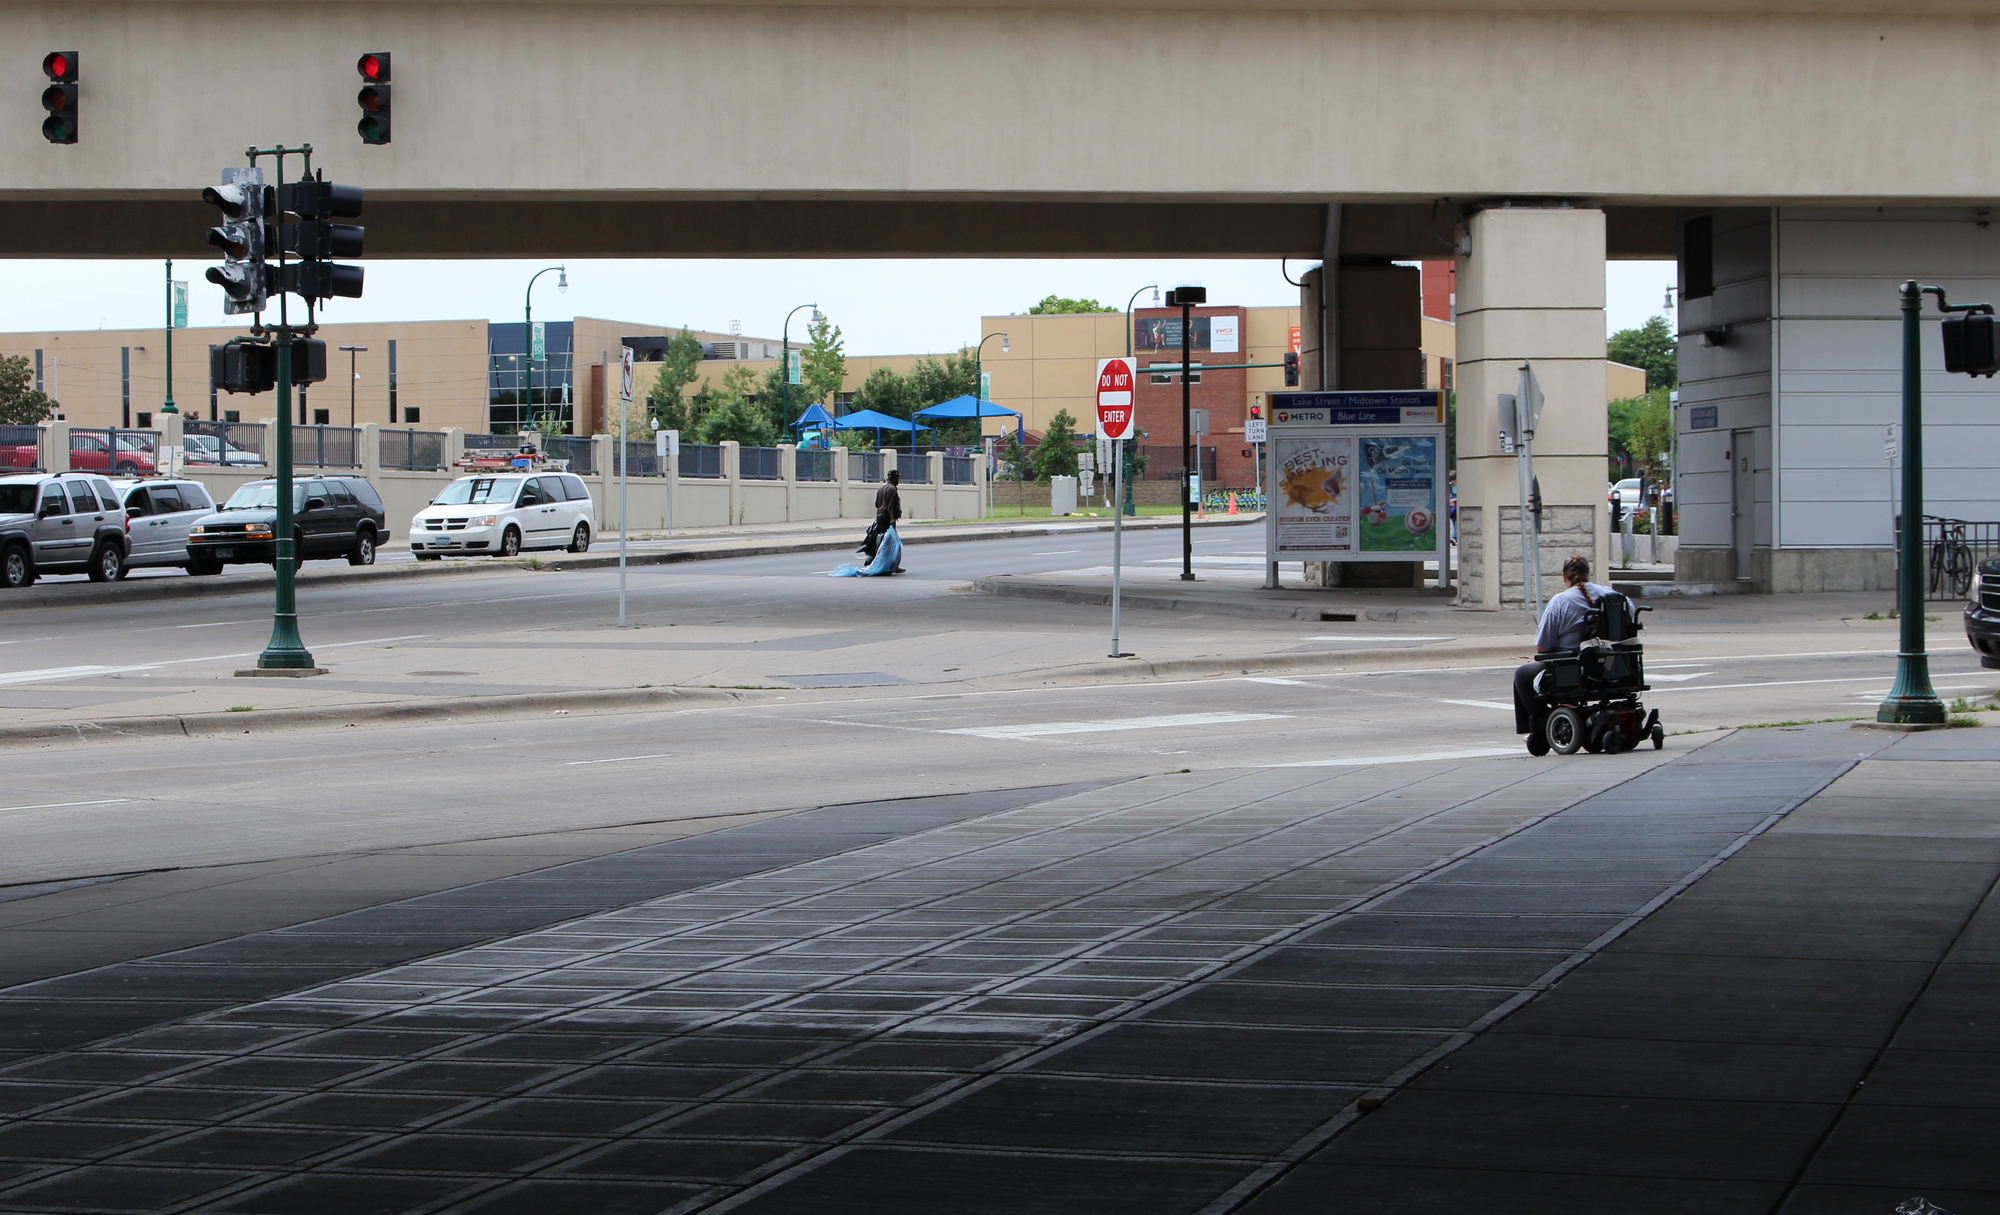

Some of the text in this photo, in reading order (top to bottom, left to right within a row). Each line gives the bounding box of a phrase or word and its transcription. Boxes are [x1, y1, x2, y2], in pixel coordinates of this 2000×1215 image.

[1101, 374, 1129, 387] DO NOT
[1292, 397, 1313, 406] Lake
[1314, 397, 1341, 406] Street
[1348, 396, 1387, 405] Midtown
[1389, 395, 1420, 405] Station
[1103, 410, 1125, 423] ENTER
[1290, 412, 1324, 421] METRO
[1337, 411, 1376, 421] Blue Line
[1284, 448, 1326, 472] BEST-
[1278, 455, 1348, 490] SMELLING
